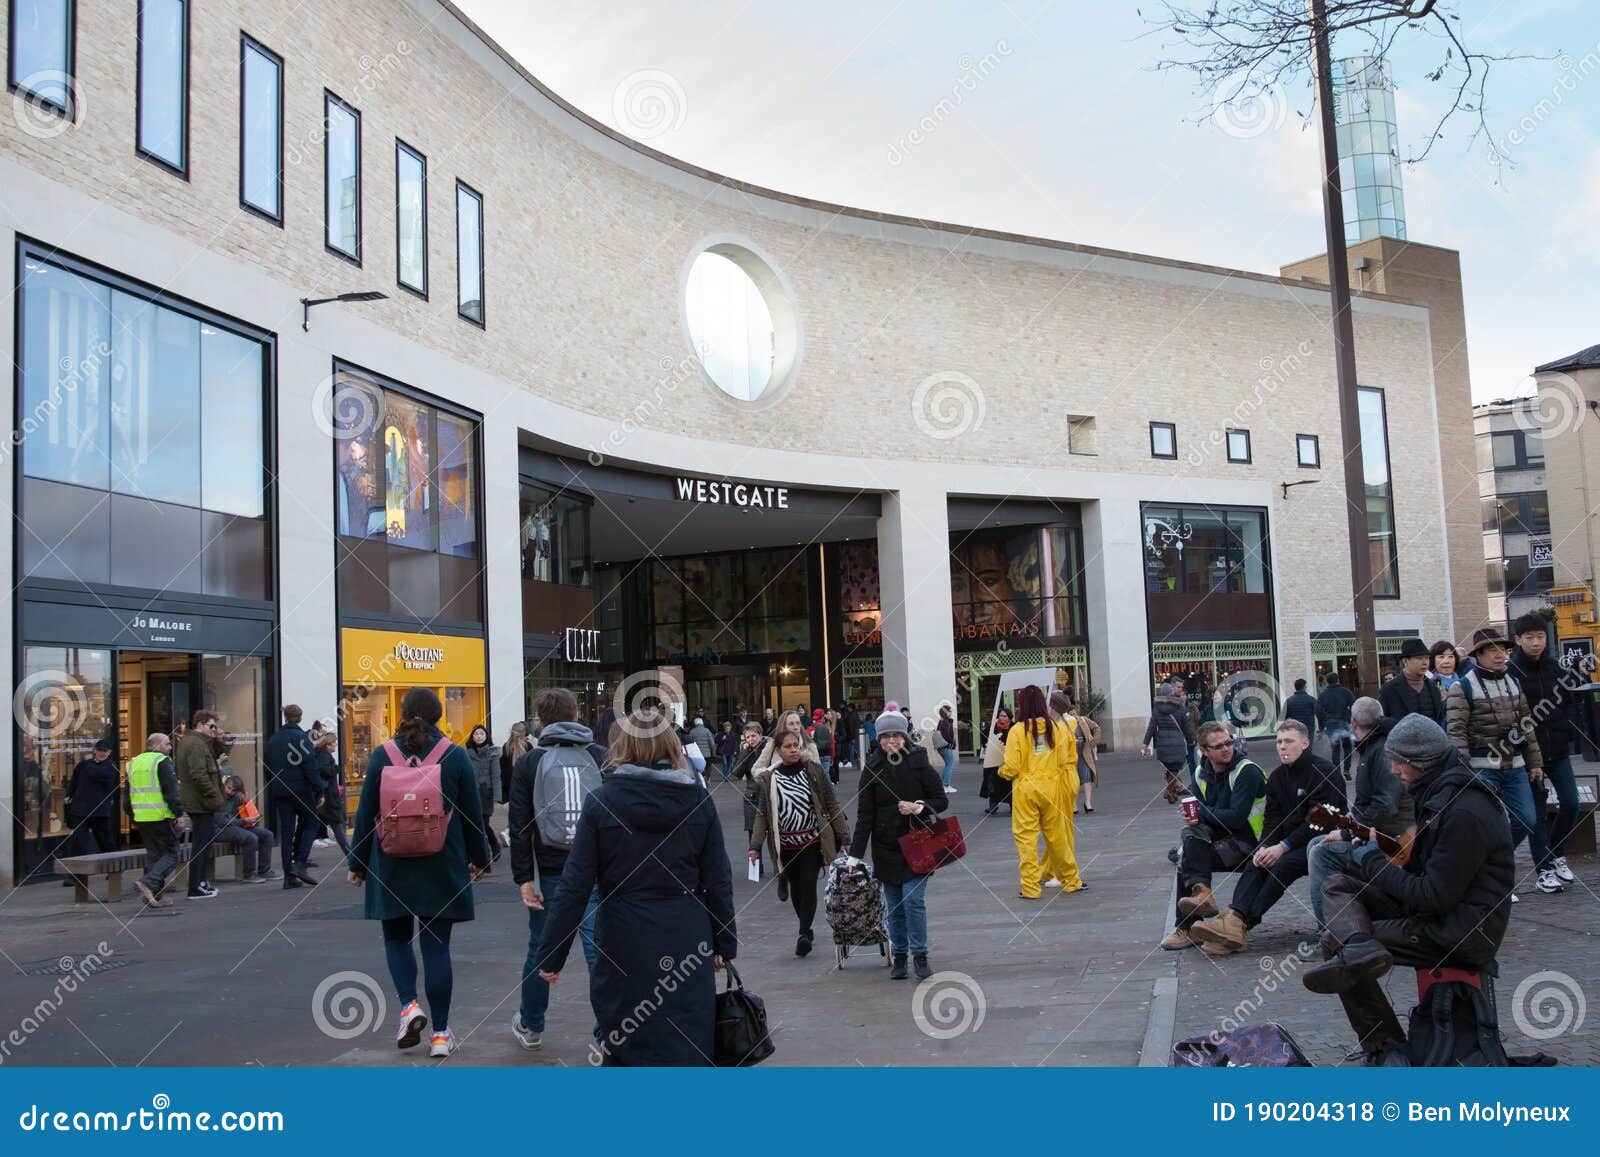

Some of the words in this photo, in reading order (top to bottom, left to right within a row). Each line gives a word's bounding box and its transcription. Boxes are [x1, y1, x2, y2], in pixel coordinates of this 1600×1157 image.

[677, 478, 789, 509] WESTGATE
[1535, 552, 1552, 560] Caf
[953, 620, 1039, 640] IBANAIS
[1567, 647, 1583, 657] Art
